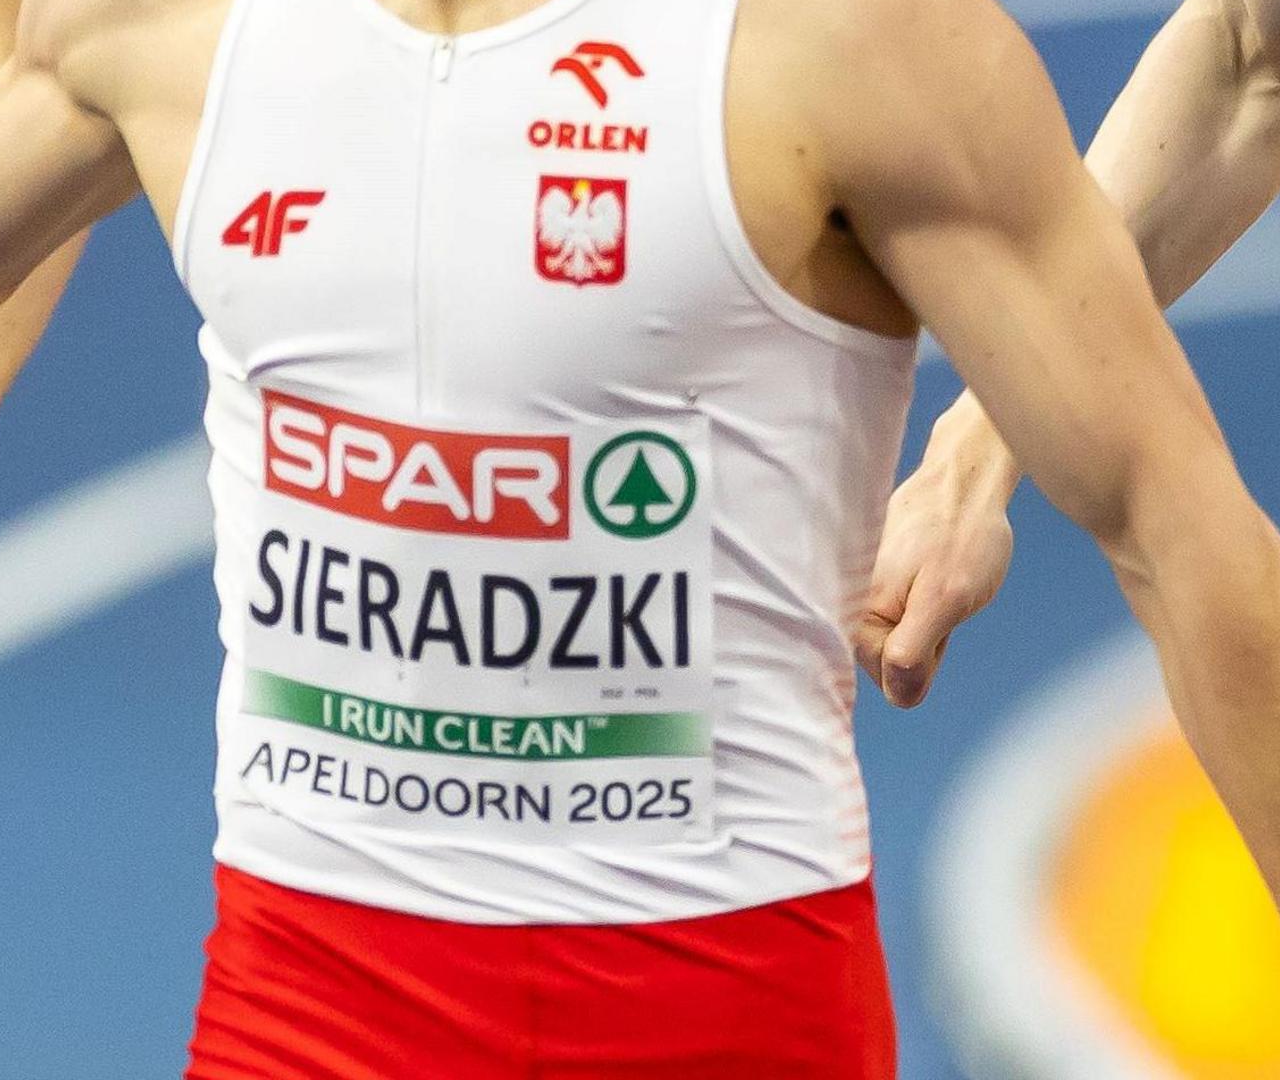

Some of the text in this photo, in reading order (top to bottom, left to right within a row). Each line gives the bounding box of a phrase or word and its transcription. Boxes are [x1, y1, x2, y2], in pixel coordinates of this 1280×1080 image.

[527, 120, 649, 153] ORLEN
[221, 190, 326, 256] 4F
[268, 405, 562, 526] SPAR
[248, 528, 690, 670] SIERADZKI
[322, 693, 333, 727] I
[340, 697, 423, 746] RUN
[239, 741, 694, 823] APELDOORN 2025
